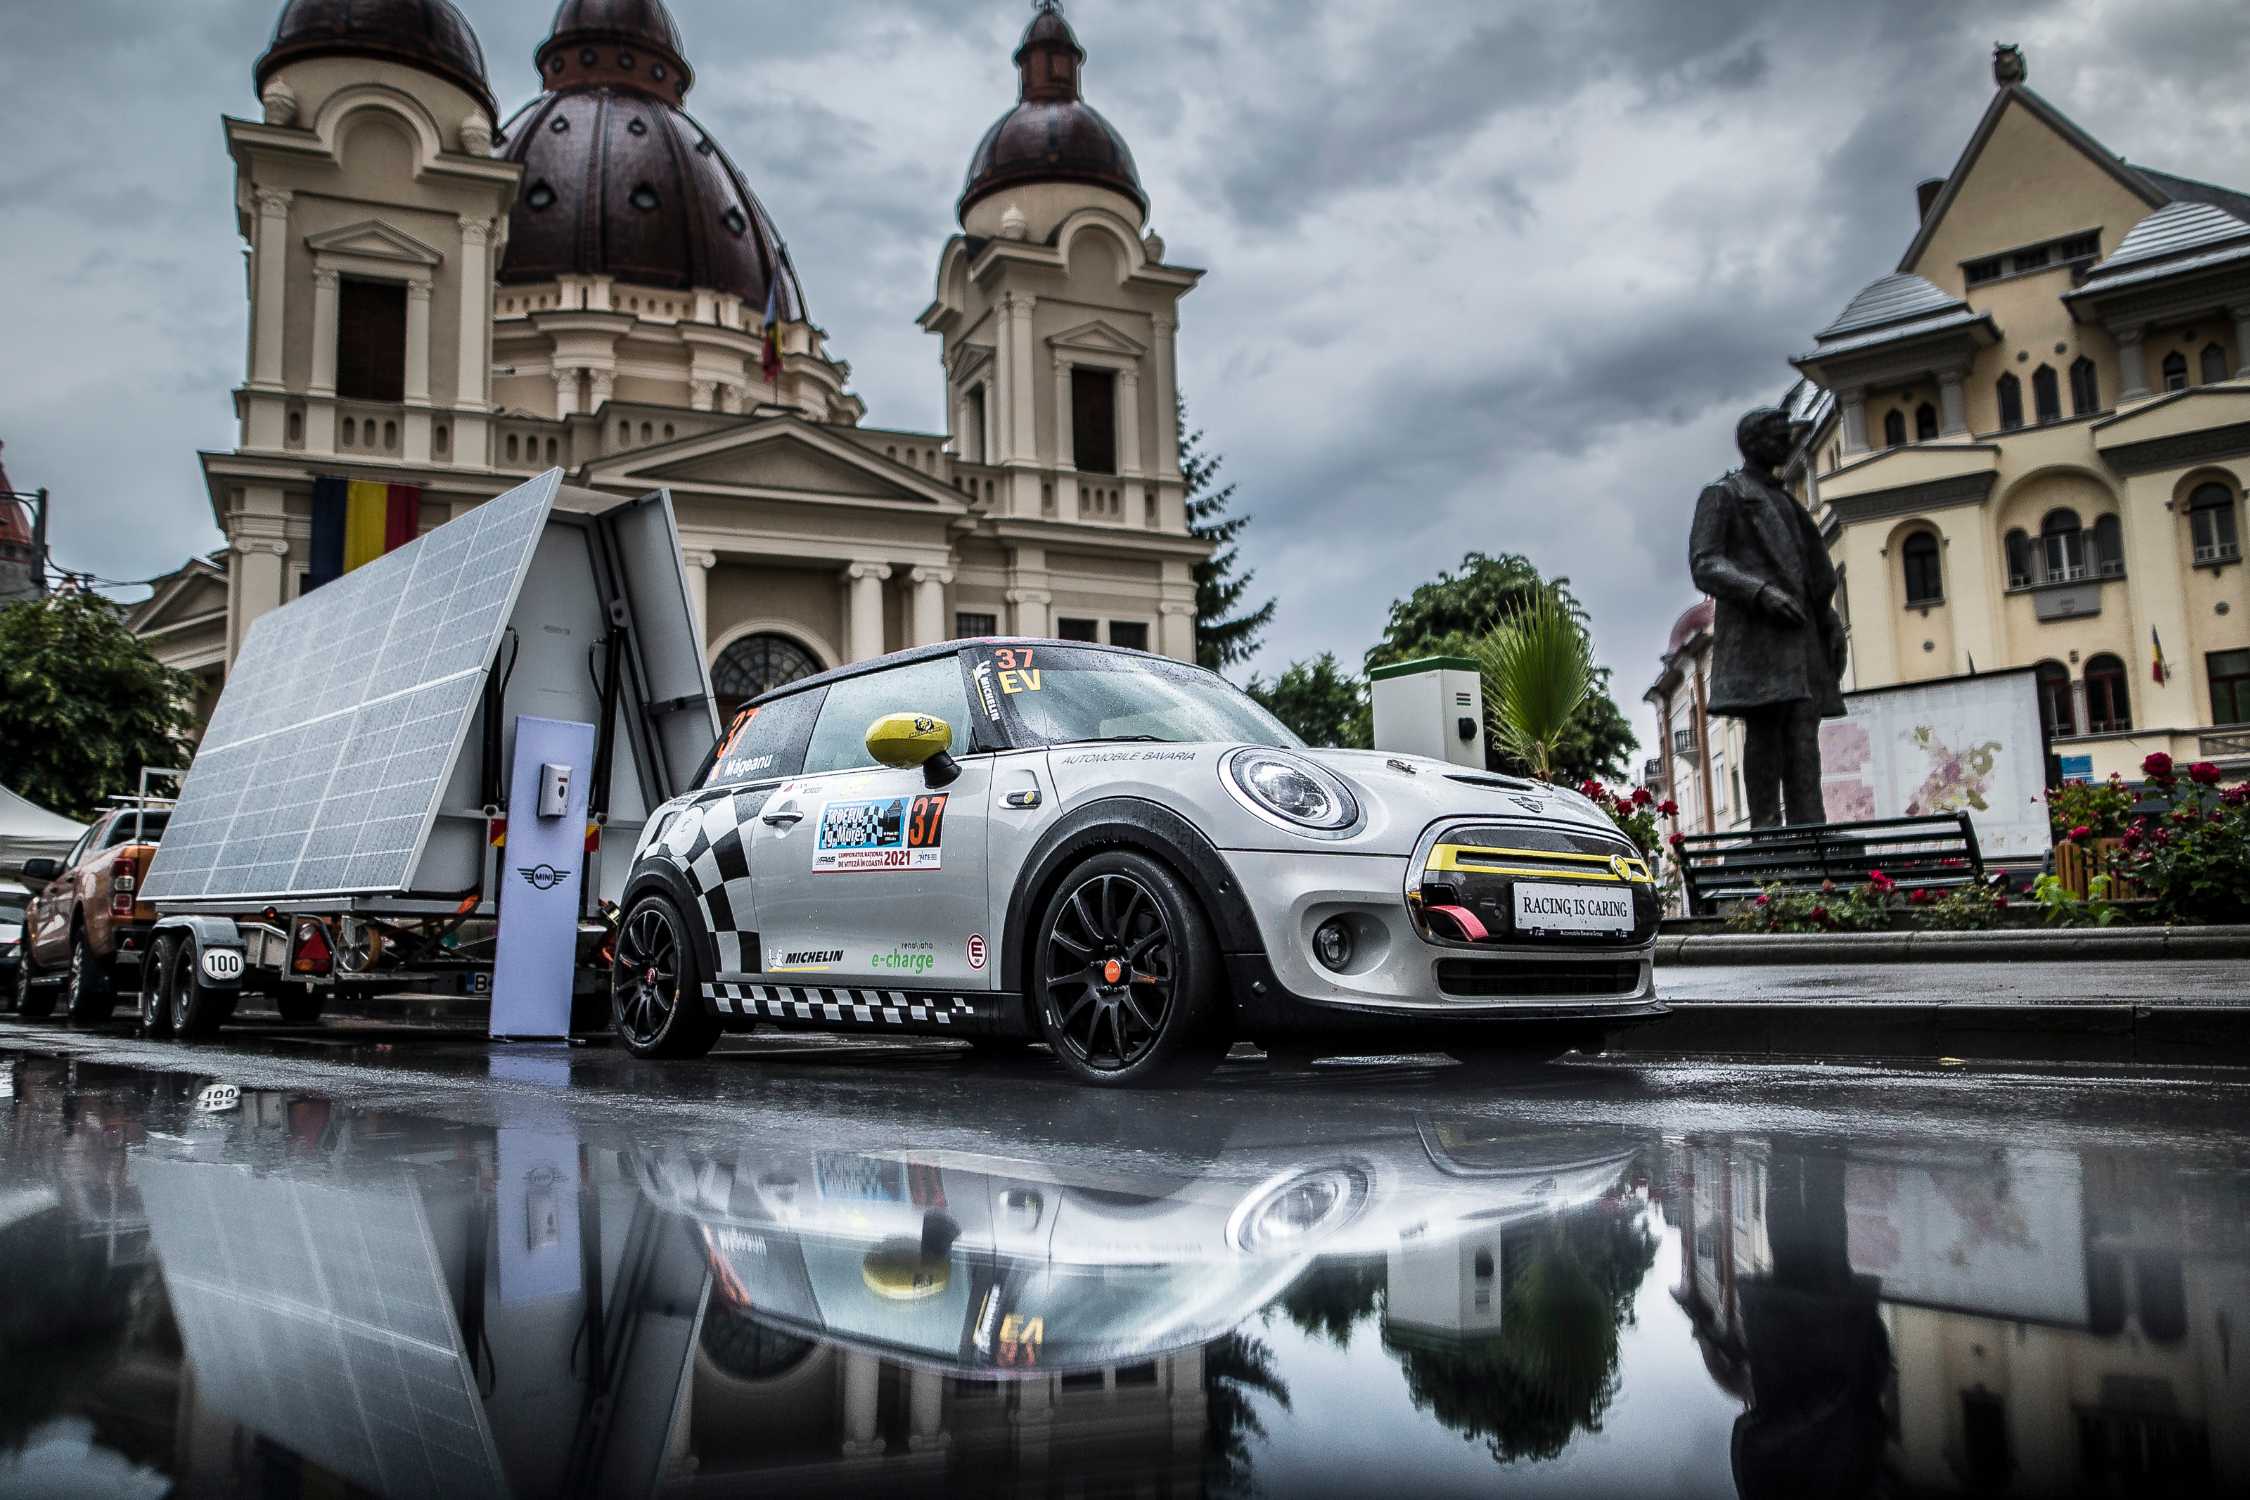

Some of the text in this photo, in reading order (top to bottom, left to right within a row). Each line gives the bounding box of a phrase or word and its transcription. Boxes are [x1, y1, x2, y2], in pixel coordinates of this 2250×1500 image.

[995, 648, 1033, 669] 37
[998, 669, 1040, 694] EV
[980, 676, 1000, 721] MICHELIN
[1063, 752, 1196, 764] AUTOMOBILE BAVARIA
[910, 796, 946, 846] 37
[884, 850, 910, 866] 2021
[535, 873, 553, 881] MINI
[1523, 897, 1627, 917] RACING IS CARING
[785, 950, 844, 964] MICHELIN
[971, 942, 983, 957] E
[209, 955, 239, 972] 100
[872, 948, 934, 974] e-charge
